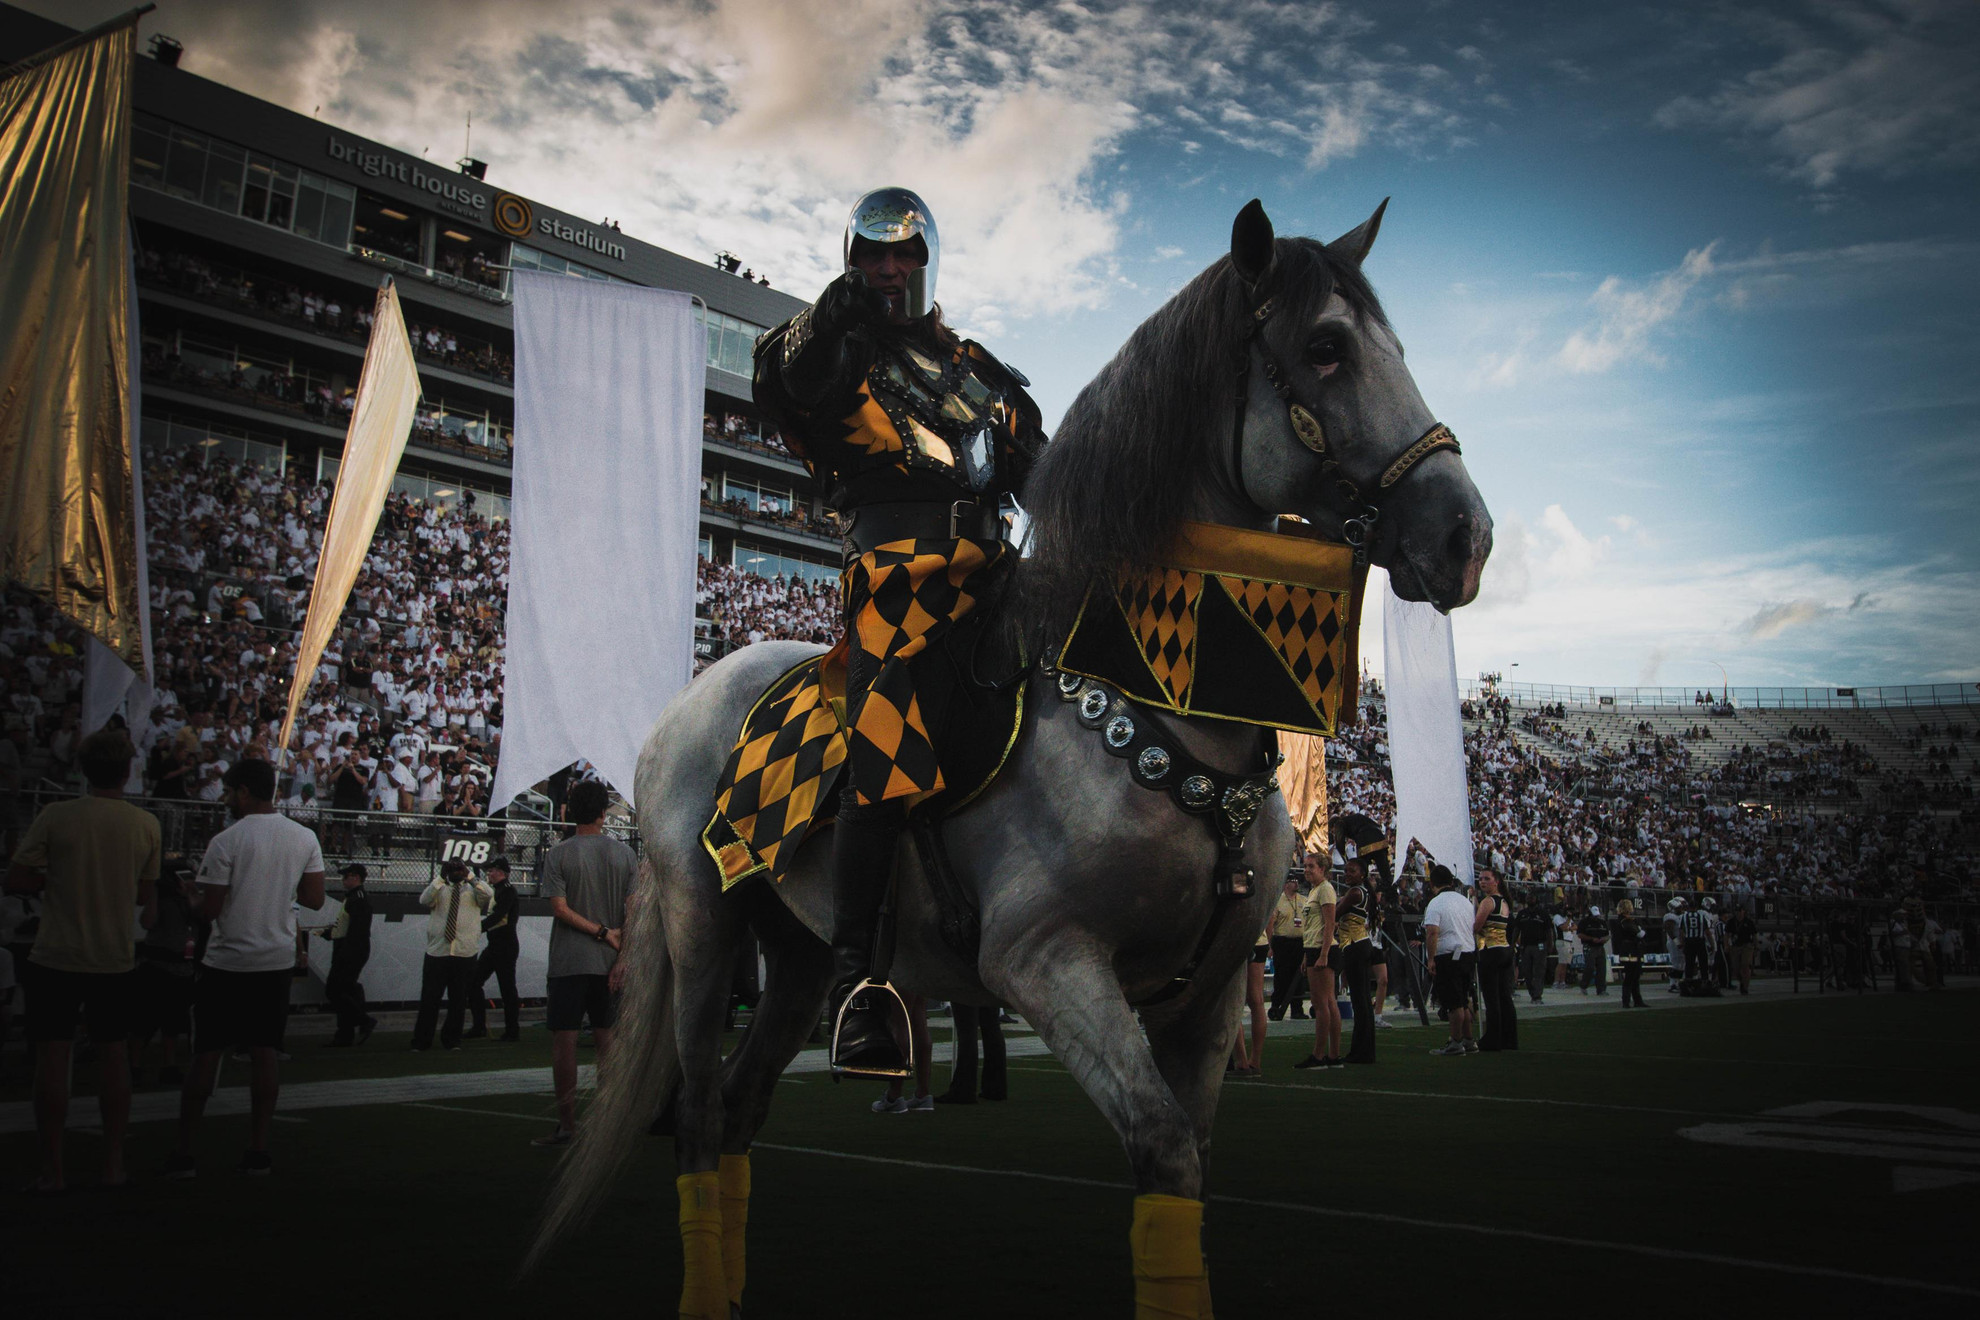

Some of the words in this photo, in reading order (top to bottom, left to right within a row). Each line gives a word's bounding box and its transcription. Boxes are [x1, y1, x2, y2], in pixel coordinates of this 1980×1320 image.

[328, 133, 408, 183] bright
[412, 167, 486, 209] house
[539, 218, 625, 260] stadium
[695, 643, 711, 653] 210
[442, 839, 490, 864] 108
